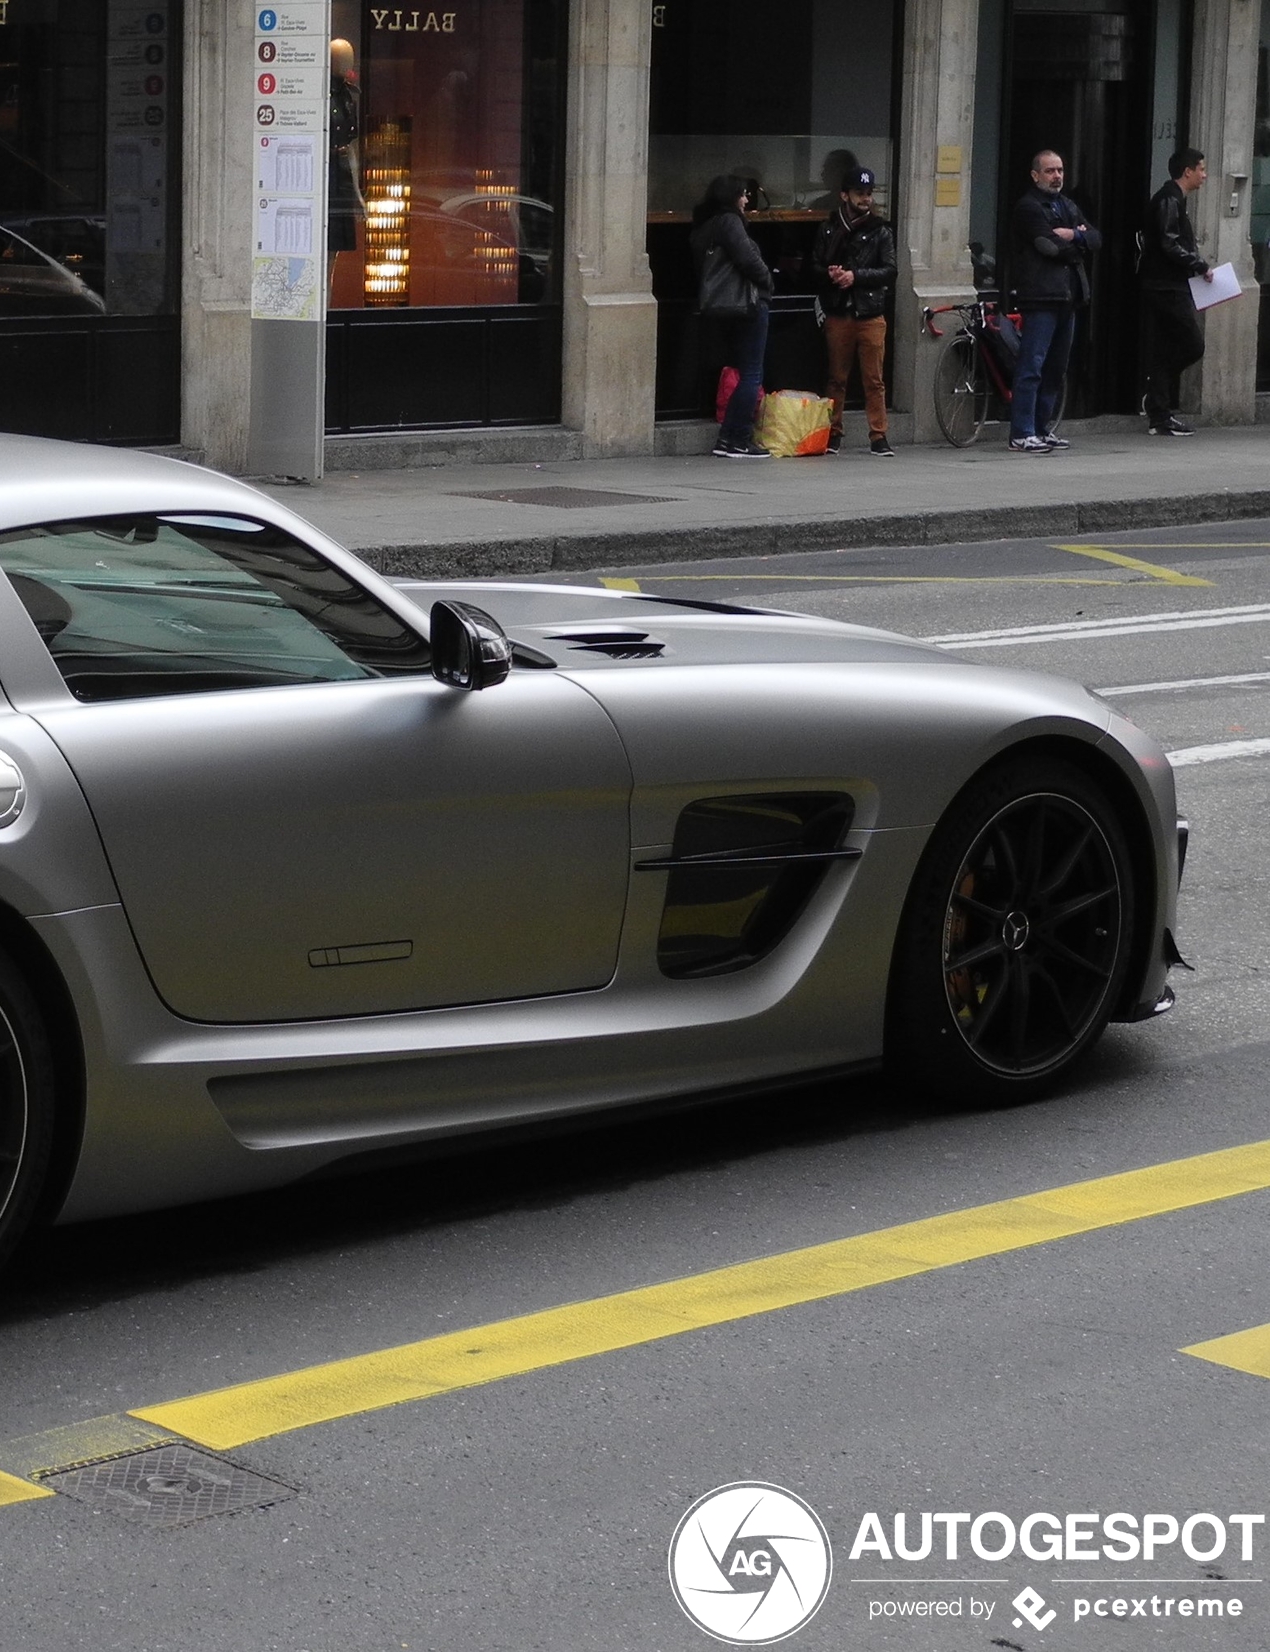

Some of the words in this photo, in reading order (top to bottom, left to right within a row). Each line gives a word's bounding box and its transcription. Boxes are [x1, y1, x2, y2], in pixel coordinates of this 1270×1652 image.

[263, 13, 271, 27] 6
[263, 45, 271, 59] 8
[263, 77, 271, 91] 9
[259, 109, 273, 122] 25
